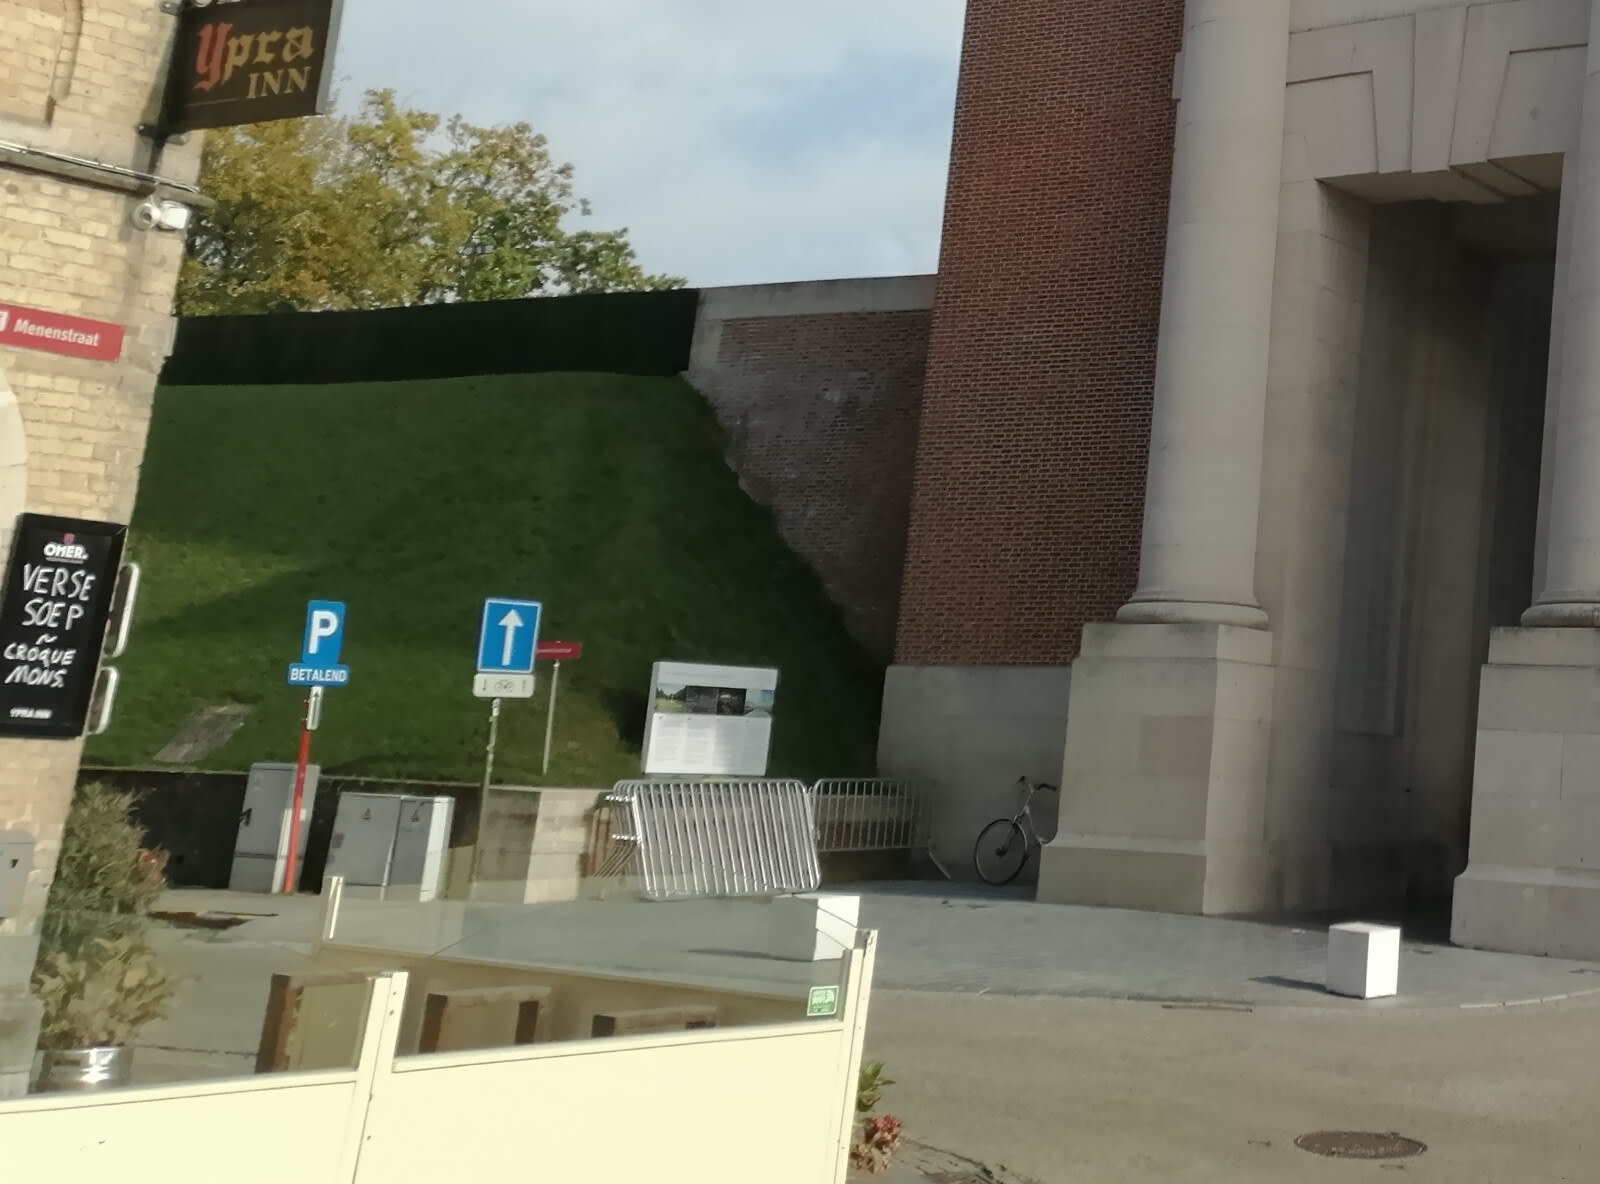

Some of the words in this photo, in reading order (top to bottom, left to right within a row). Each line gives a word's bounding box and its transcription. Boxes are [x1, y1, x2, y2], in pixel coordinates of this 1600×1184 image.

[192, 21, 315, 91] Ypra
[246, 65, 312, 100] INN
[13, 318, 101, 347] Menenstraat
[22, 562, 97, 602] VERSE
[21, 596, 85, 631] SOEP
[308, 609, 339, 655] P
[289, 667, 348, 683] BETALEND
